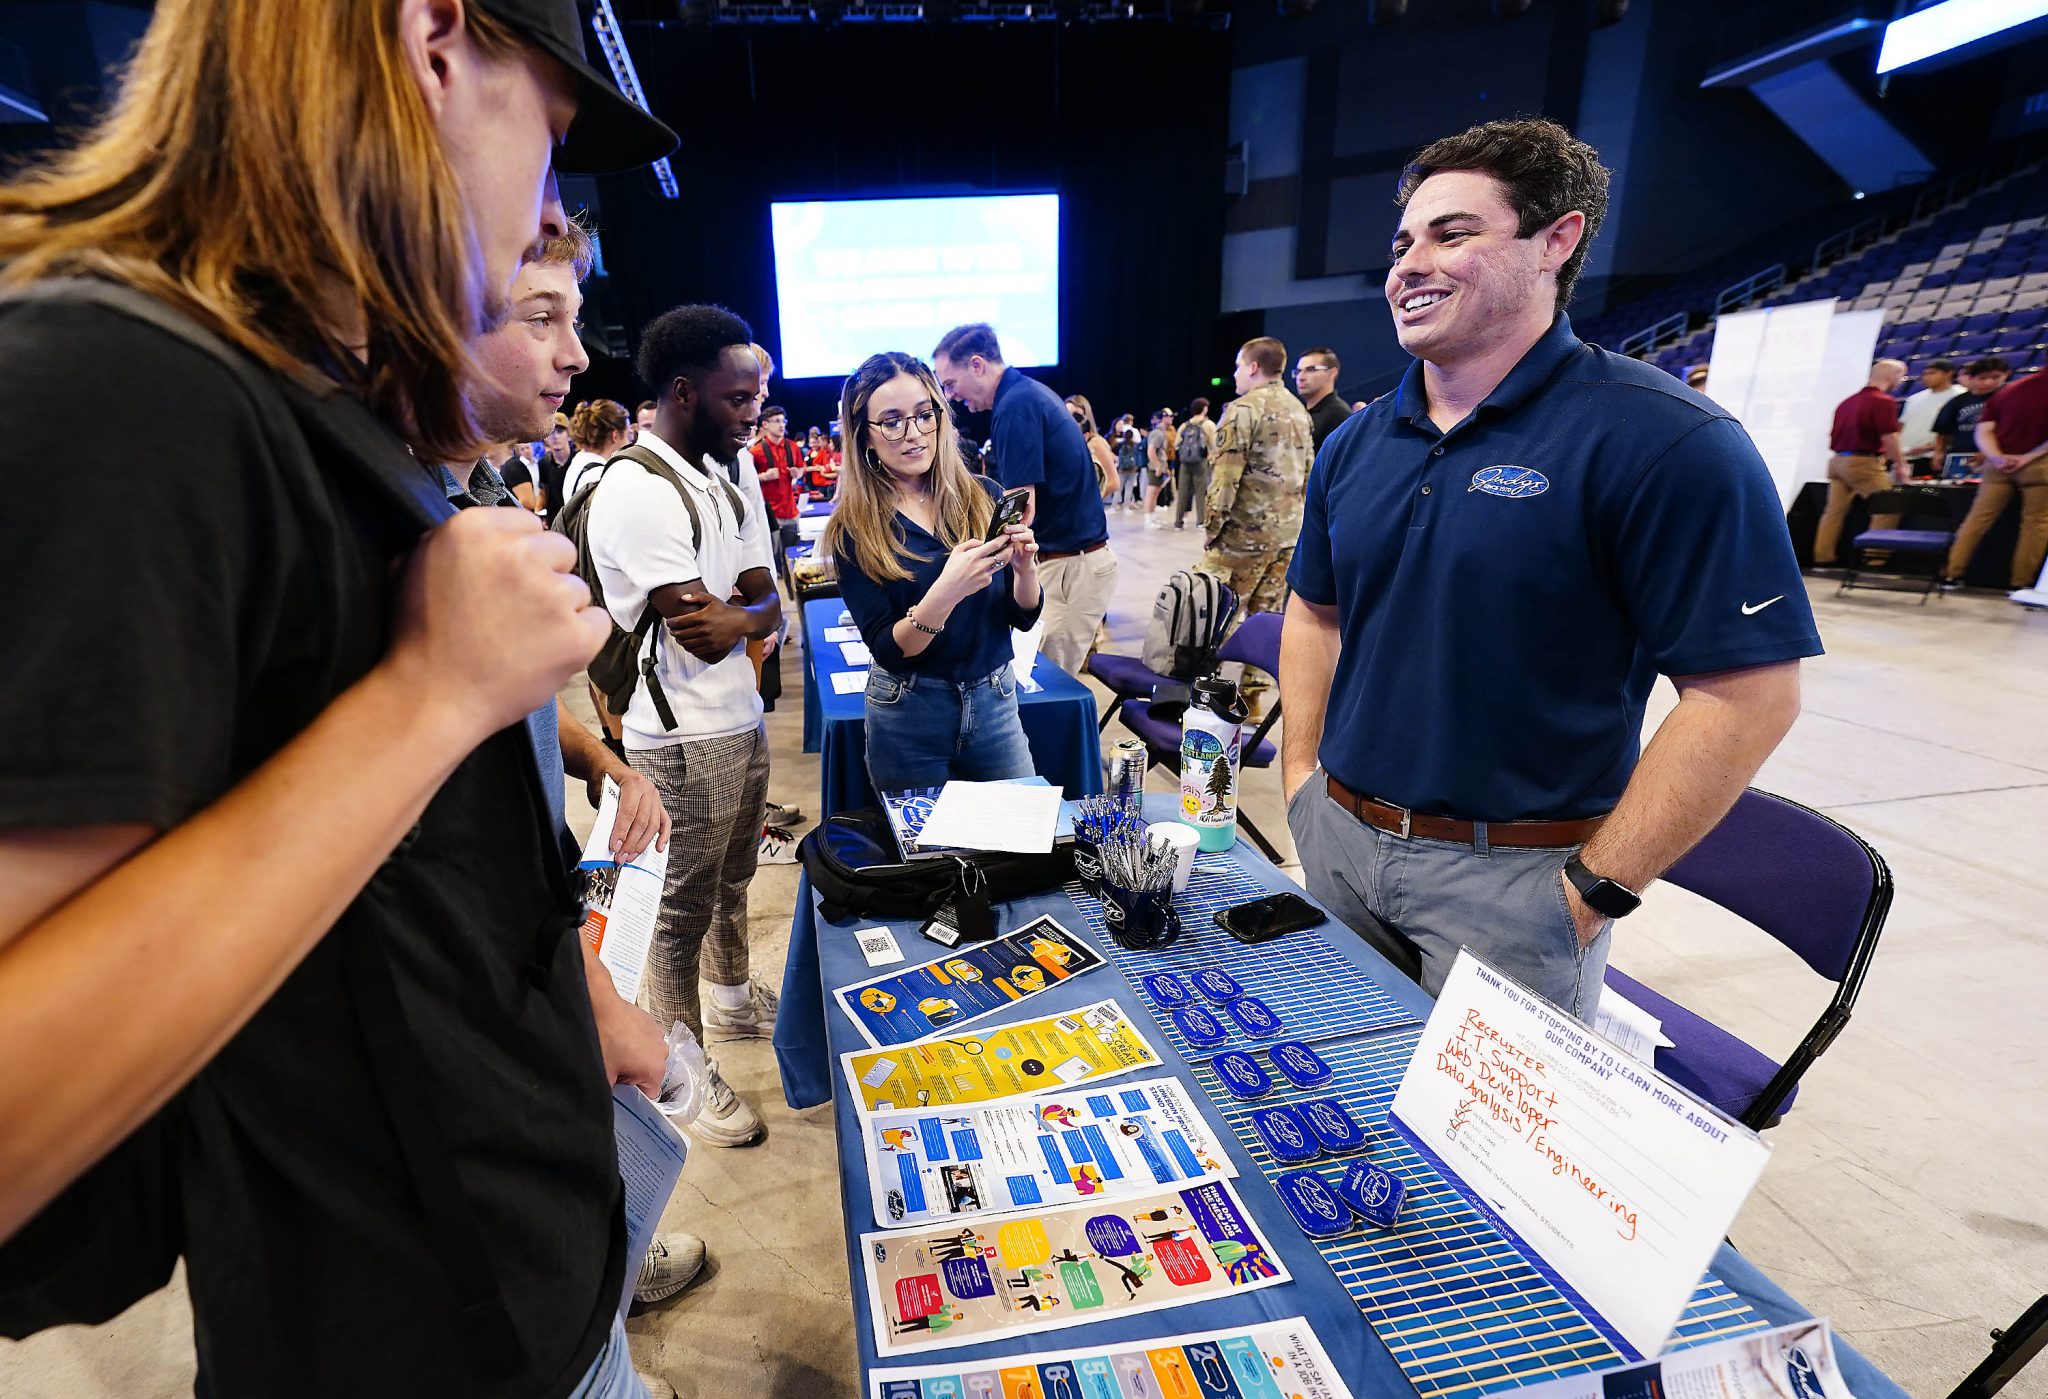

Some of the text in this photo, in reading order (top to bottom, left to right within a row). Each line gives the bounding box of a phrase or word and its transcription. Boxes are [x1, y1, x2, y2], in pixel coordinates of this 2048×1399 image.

[1114, 1040, 1138, 1065] CREATE
[1436, 1053, 1465, 1083] Data
[1475, 966, 1729, 1144] THANK YOU FOR STOPPING BY TO LEARN MORE ABOUT
[1545, 1030, 1613, 1081] OUR COMPANY
[1149, 1086, 1175, 1123] STAND OUT
[1164, 1084, 1176, 1098] HOW
[1445, 1038, 1559, 1131] Web Developer
[1156, 1085, 1197, 1143] LINKEDIN PROFILE
[1202, 1187, 1213, 1203] THE
[1211, 1202, 1225, 1221] NEW
[1221, 1220, 1236, 1237] JOB
[1208, 1185, 1225, 1207] FIRST
[1221, 1207, 1235, 1223] DAY
[1231, 1223, 1243, 1234] AT
[1468, 1194, 1489, 1216] GRAND
[1489, 1214, 1515, 1241] CANYON
[1494, 1173, 1539, 1218] INTERNATIONAL
[1540, 1215, 1575, 1249] STUDENTS
[1190, 1345, 1216, 1361] 2
[1288, 1351, 1298, 1361] IN
[1297, 1370, 1312, 1385] JOB
[1289, 1333, 1307, 1357] WHAT
[1304, 1358, 1314, 1370] TO
[1310, 1371, 1325, 1386] SAY
